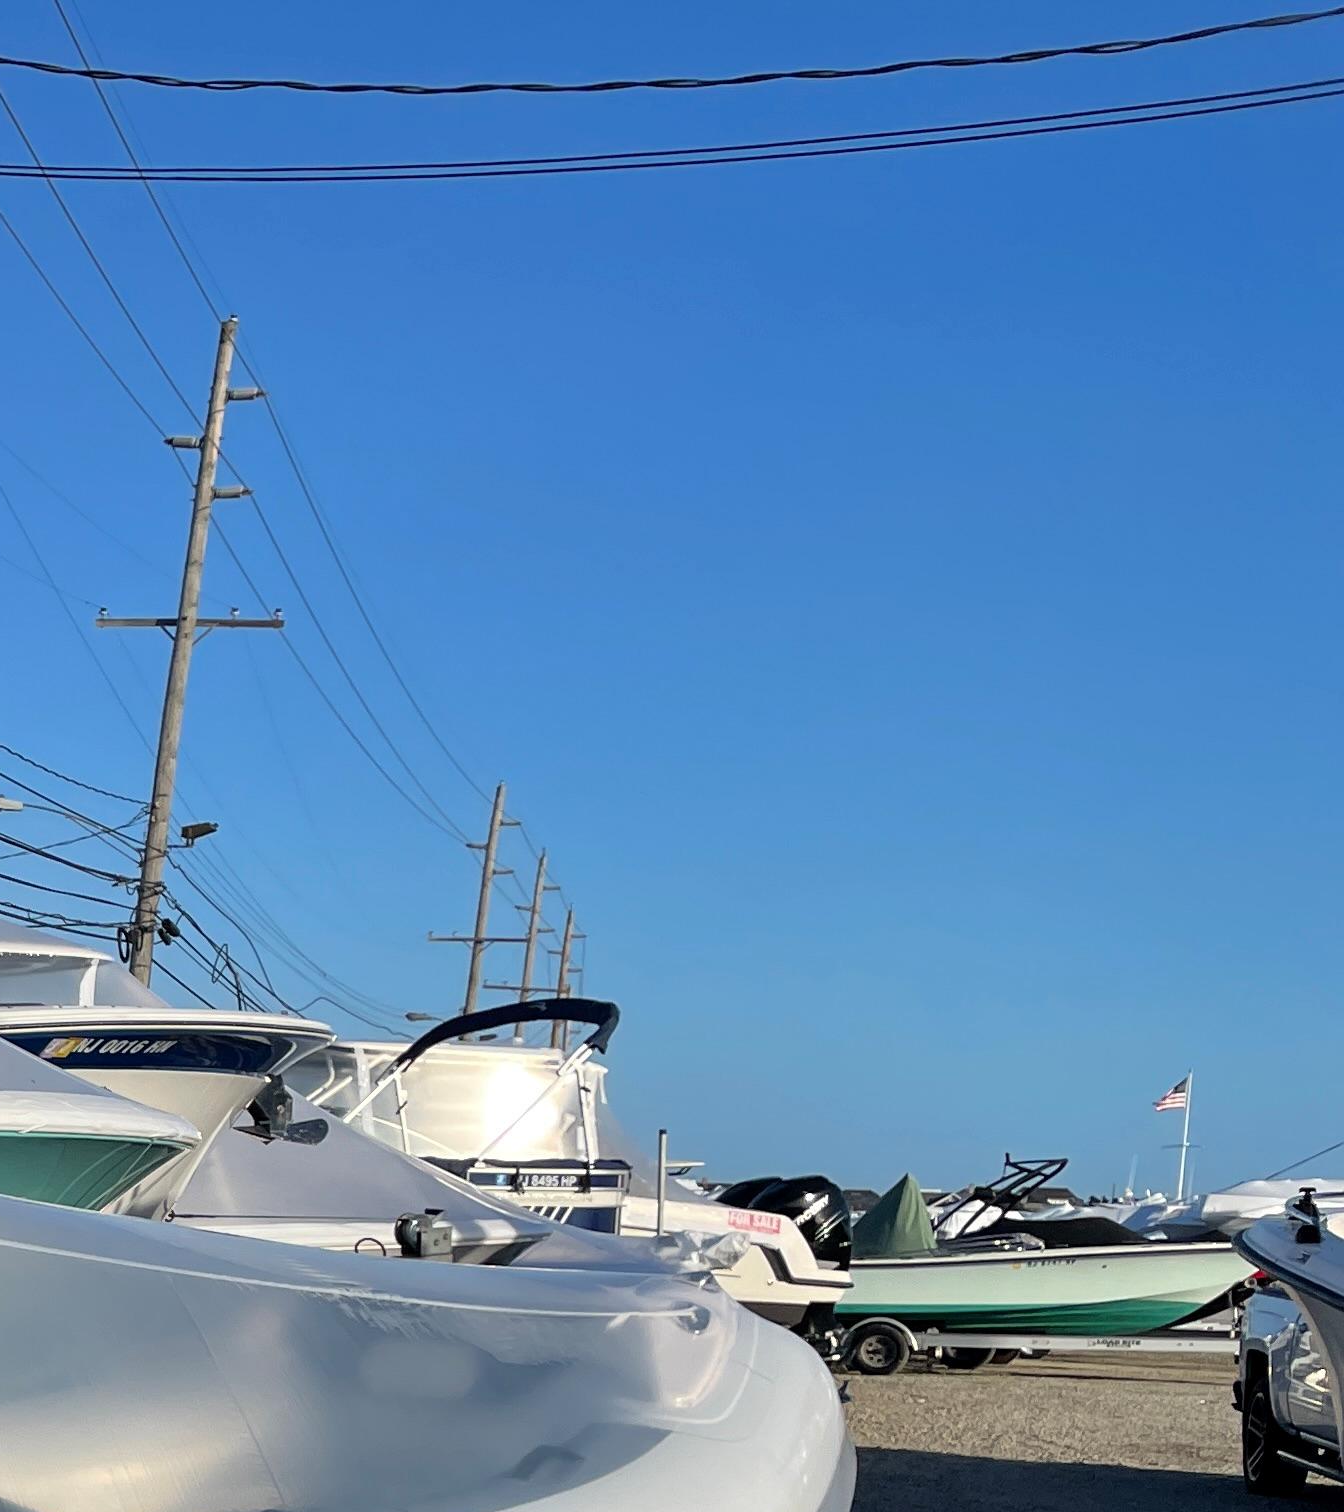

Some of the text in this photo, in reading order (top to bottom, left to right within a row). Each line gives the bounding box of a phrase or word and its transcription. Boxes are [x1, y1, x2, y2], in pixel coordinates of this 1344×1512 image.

[73, 1038, 104, 1053] NJ
[99, 1039, 149, 1054] 0016
[531, 1174, 559, 1187] 8495
[560, 1175, 577, 1187] HP
[729, 1210, 780, 1230] FOR SALE
